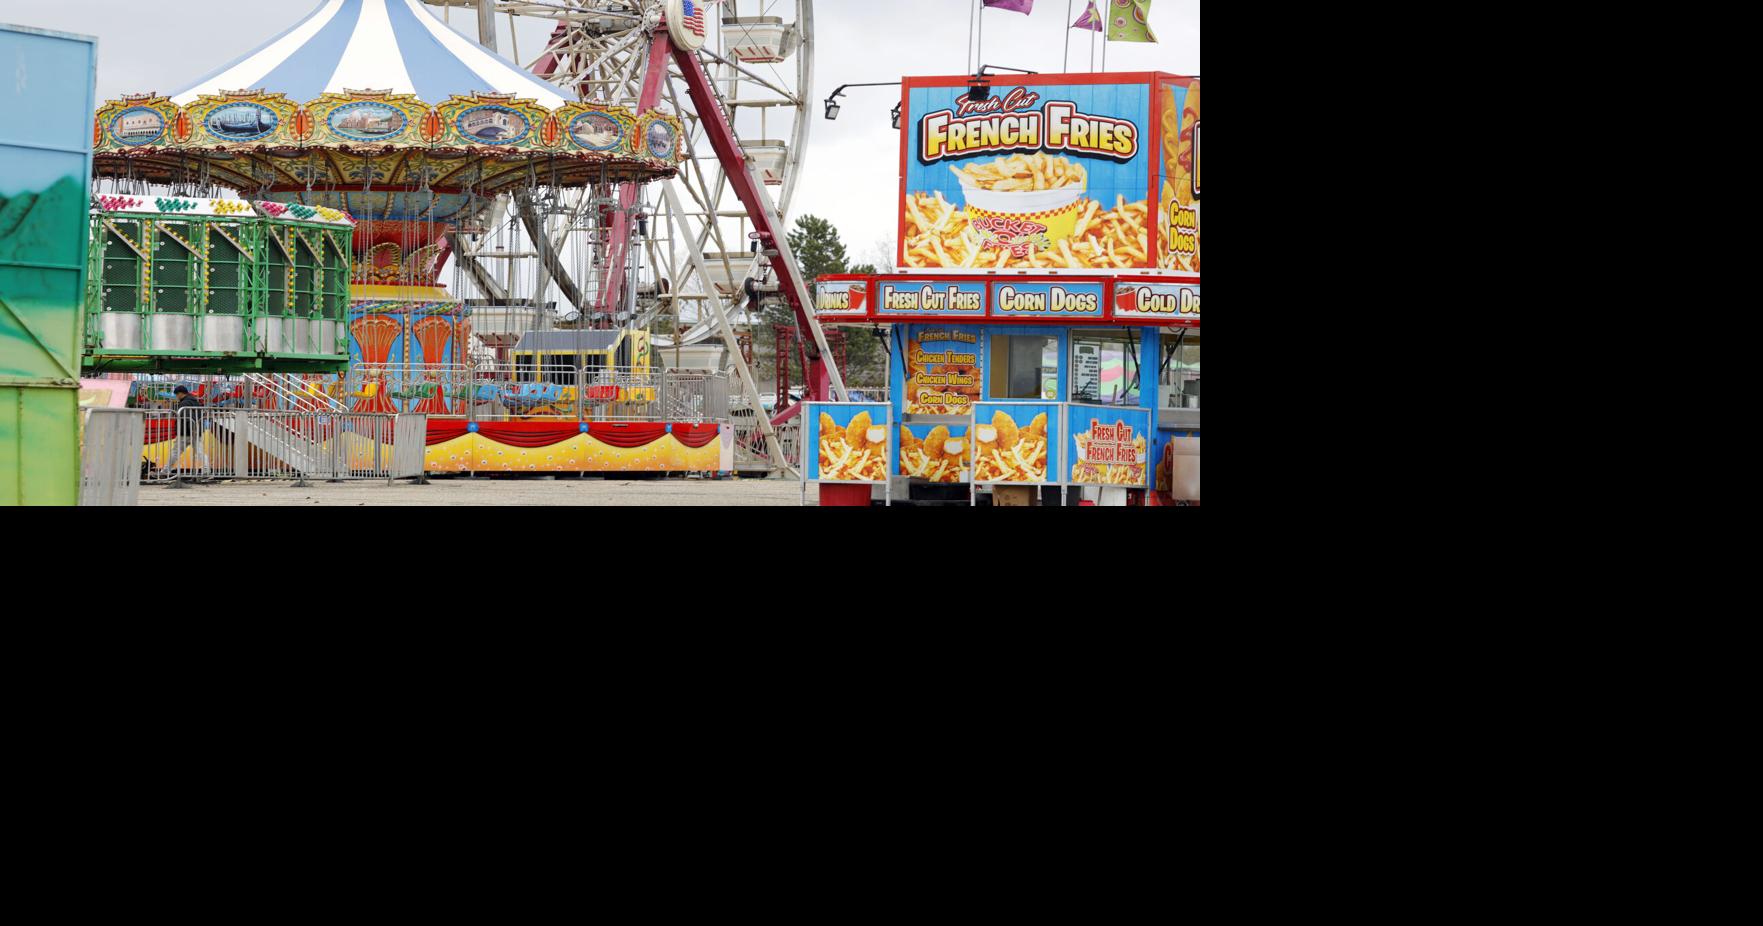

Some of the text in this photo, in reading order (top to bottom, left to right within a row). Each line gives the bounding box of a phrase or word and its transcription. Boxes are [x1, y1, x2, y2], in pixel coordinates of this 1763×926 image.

[1002, 87, 1038, 111] Cut
[925, 104, 1135, 157] FRENCH FRIES
[972, 216, 1048, 236] BUCKET
[1169, 200, 1196, 228] CORN
[1169, 225, 1195, 253] DOGS
[820, 285, 849, 310] DRINKS
[883, 285, 980, 311] FRESH CUT FRIES
[999, 285, 1098, 312] CORN DOGS
[1136, 286, 1200, 314] COLD DR
[952, 329, 976, 343] FRIE
[916, 349, 976, 364] CHICKEN TENDERS
[916, 372, 973, 386] CHICKEN WINGS
[920, 391, 967, 405] CORN DOGS
[1092, 421, 1132, 443] FRESH CUT
[1086, 442, 1136, 462] FRENCH FRIES
